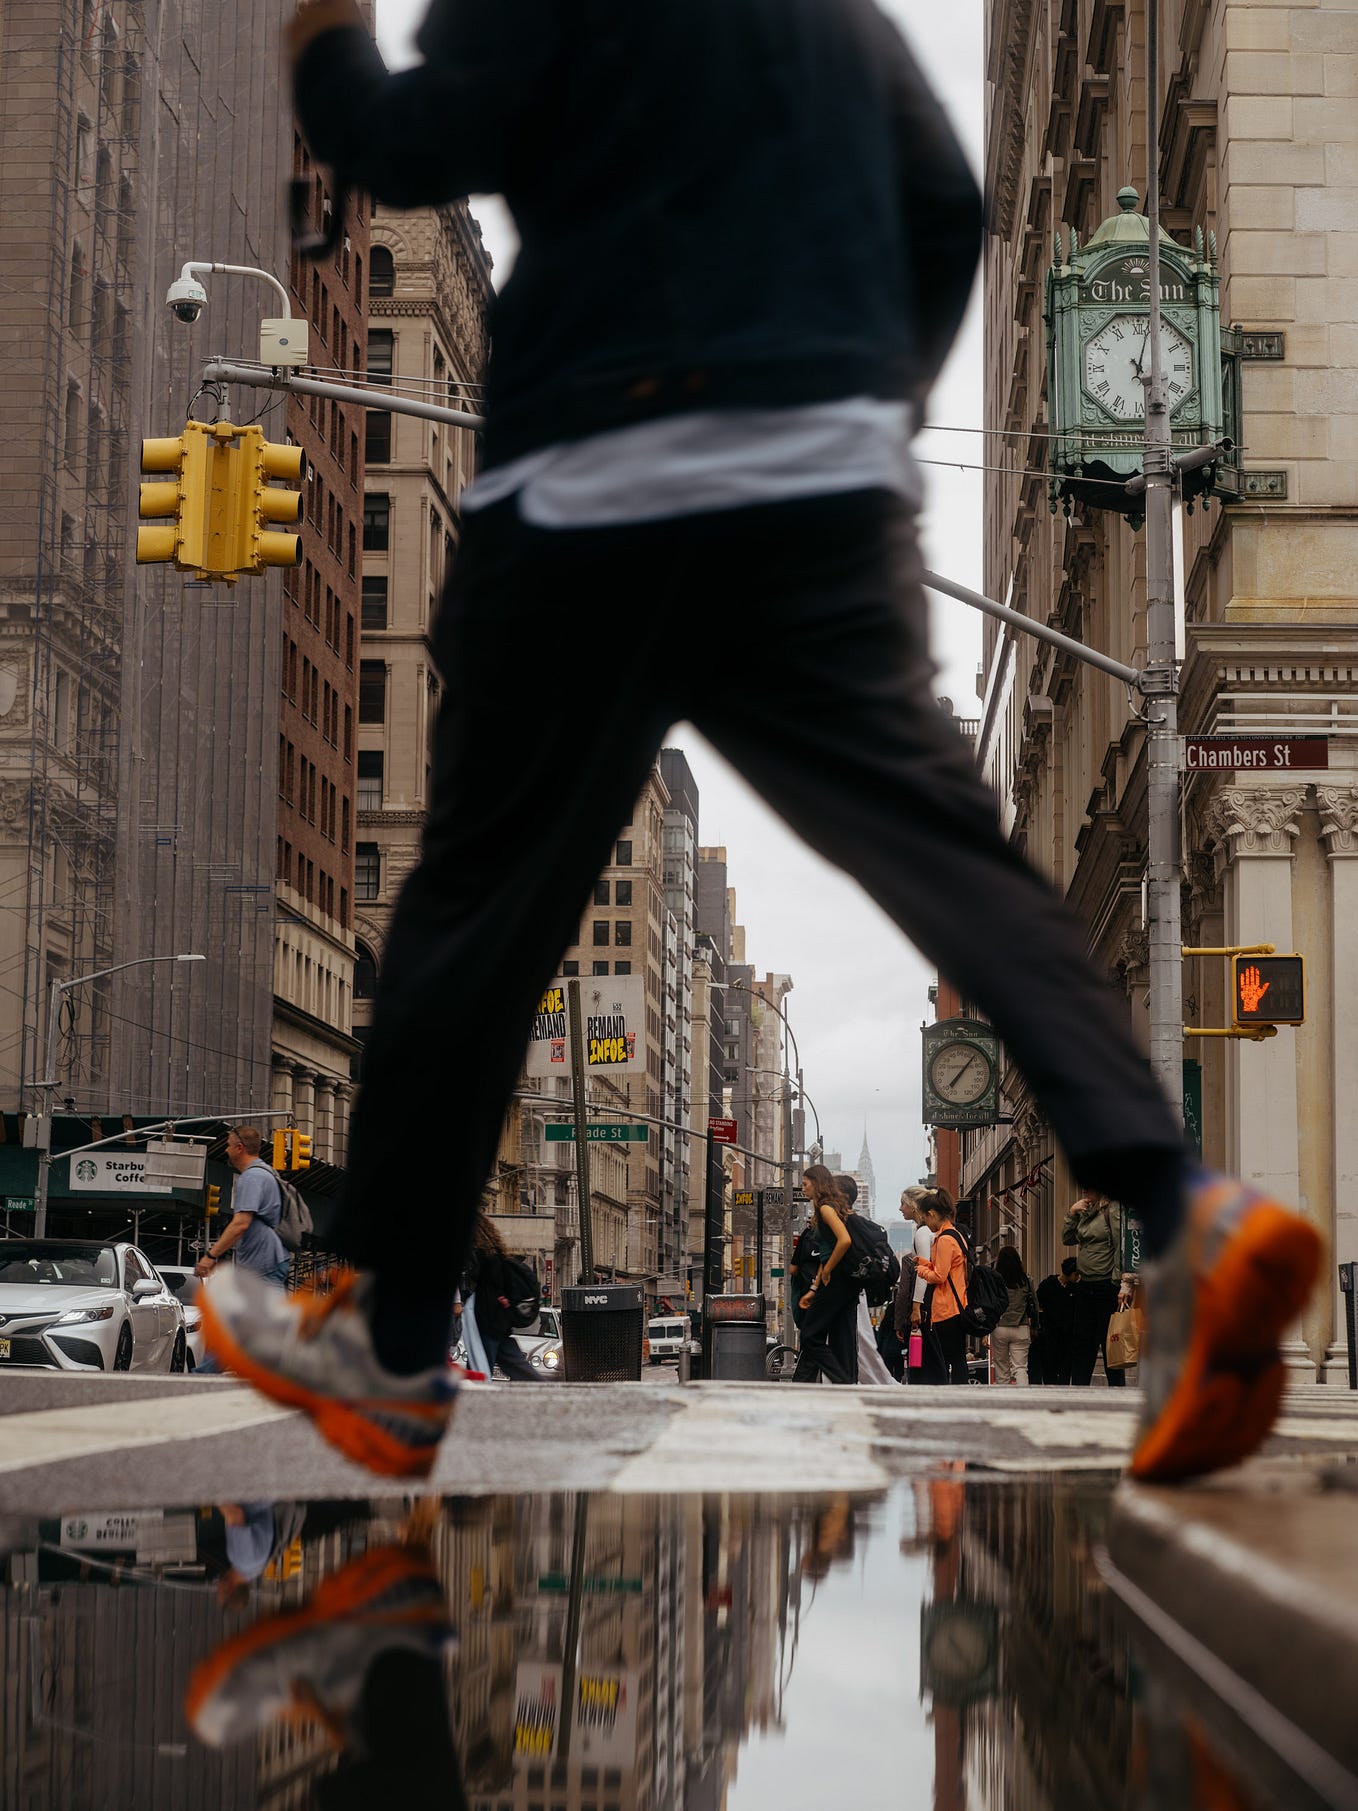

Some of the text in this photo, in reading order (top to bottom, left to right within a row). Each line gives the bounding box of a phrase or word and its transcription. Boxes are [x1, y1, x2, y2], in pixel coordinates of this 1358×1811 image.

[1091, 280, 1133, 301] The
[1187, 744, 1291, 767] Chambers St
[539, 988, 564, 1014] FOE
[587, 1016, 625, 1039] REMAND
[589, 1037, 627, 1065] INFOE
[571, 1127, 622, 1138] Rade St
[106, 1160, 144, 1171] Starbu
[115, 1173, 145, 1183] Coffe
[7, 1199, 27, 1209] Reade
[584, 1295, 608, 1305] NYC
